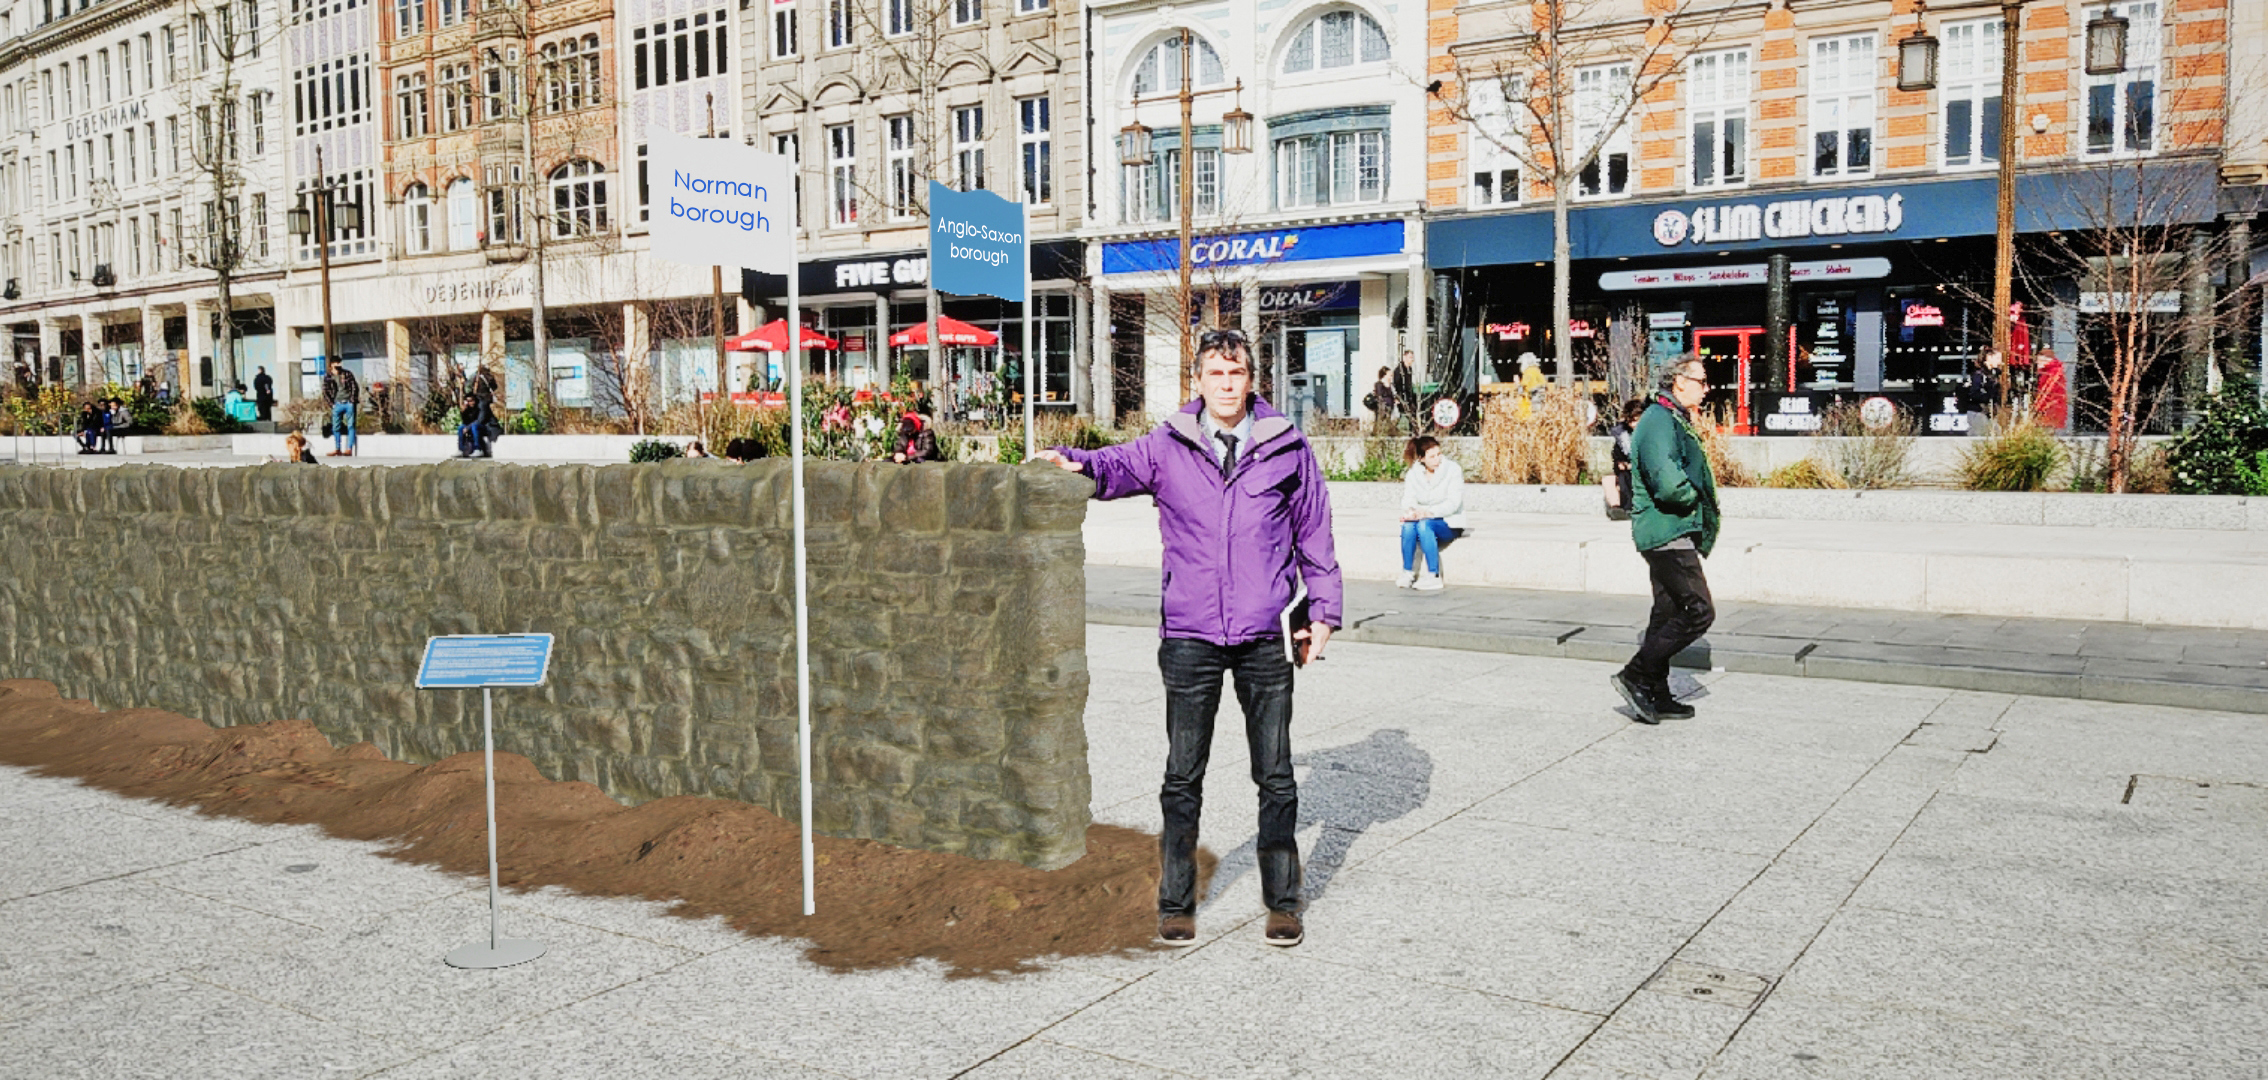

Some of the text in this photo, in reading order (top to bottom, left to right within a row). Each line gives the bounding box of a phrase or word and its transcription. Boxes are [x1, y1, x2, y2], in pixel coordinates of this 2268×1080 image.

[66, 99, 149, 140] DEBENHAMS
[674, 168, 768, 203] Norman
[670, 196, 770, 233] borough
[937, 216, 1022, 244] Anglo-Saxon
[1690, 192, 1903, 245] SLIM CHICKENS
[950, 242, 1009, 267] borough
[1190, 236, 1283, 264] CORAL
[836, 257, 928, 288] FIVE GU
[1260, 290, 1315, 308] ORAL
